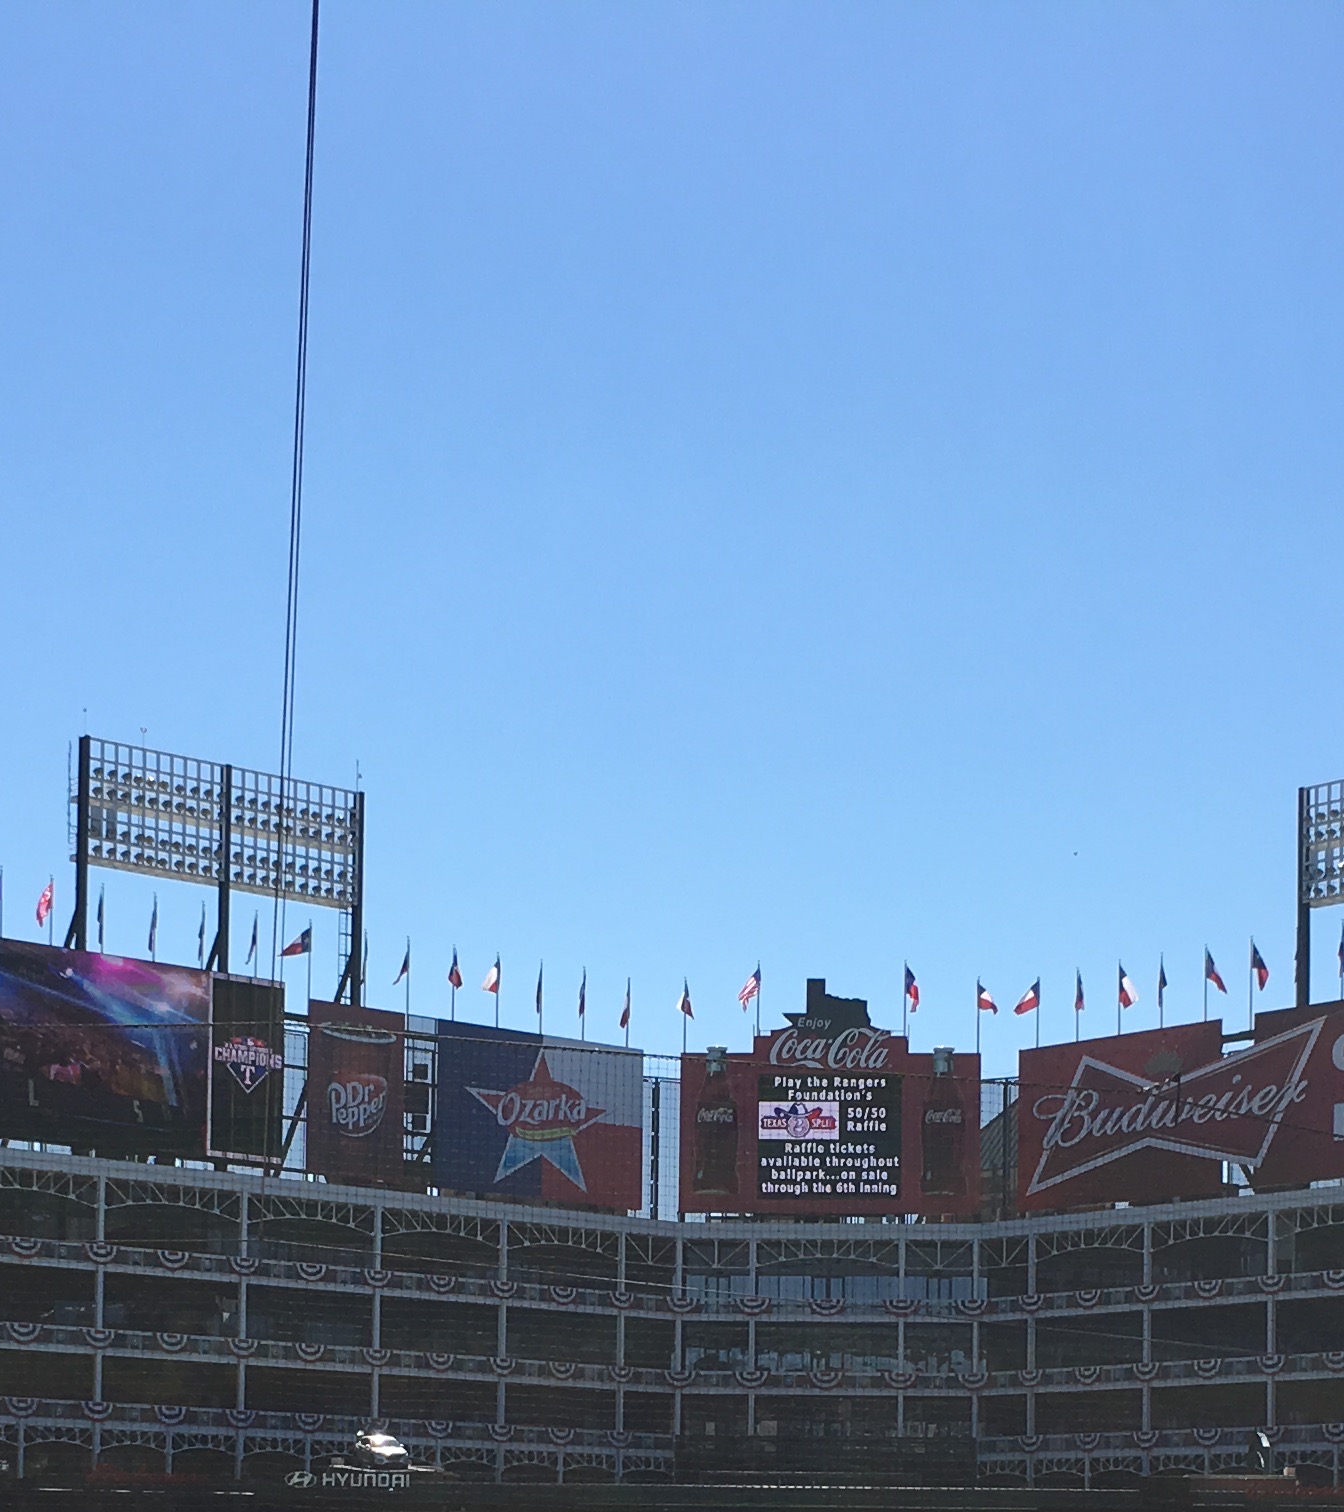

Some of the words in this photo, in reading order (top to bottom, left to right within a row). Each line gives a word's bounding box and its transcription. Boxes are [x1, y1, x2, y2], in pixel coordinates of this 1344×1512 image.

[796, 1016, 832, 1030] Enjoy
[769, 1026, 892, 1070] Coca-Cola
[214, 1046, 283, 1070] CHAMPIONS
[240, 1064, 256, 1086] T
[773, 1076, 802, 1089] Play
[807, 1076, 828, 1088] the
[833, 1076, 887, 1090] Rangers
[347, 1081, 375, 1107] Dr
[787, 1089, 874, 1101] Foundation's
[328, 1081, 387, 1131] Pepper
[496, 1091, 588, 1127] Ozarka
[1032, 1073, 1310, 1150] Budweiser
[846, 1107, 887, 1120] 50/50
[761, 1117, 787, 1129] TEXAS
[846, 1120, 888, 1132] Raffle
[784, 1142, 825, 1153] Raffle
[829, 1142, 876, 1153] tickets
[760, 1156, 821, 1168] available
[825, 1156, 900, 1169] throughout
[861, 1170, 888, 1181] sale
[761, 1182, 809, 1195] through
[812, 1182, 833, 1193] the
[836, 1182, 856, 1193] 6th
[859, 1182, 897, 1196] inning
[322, 1473, 410, 1488] HYUNDAI
